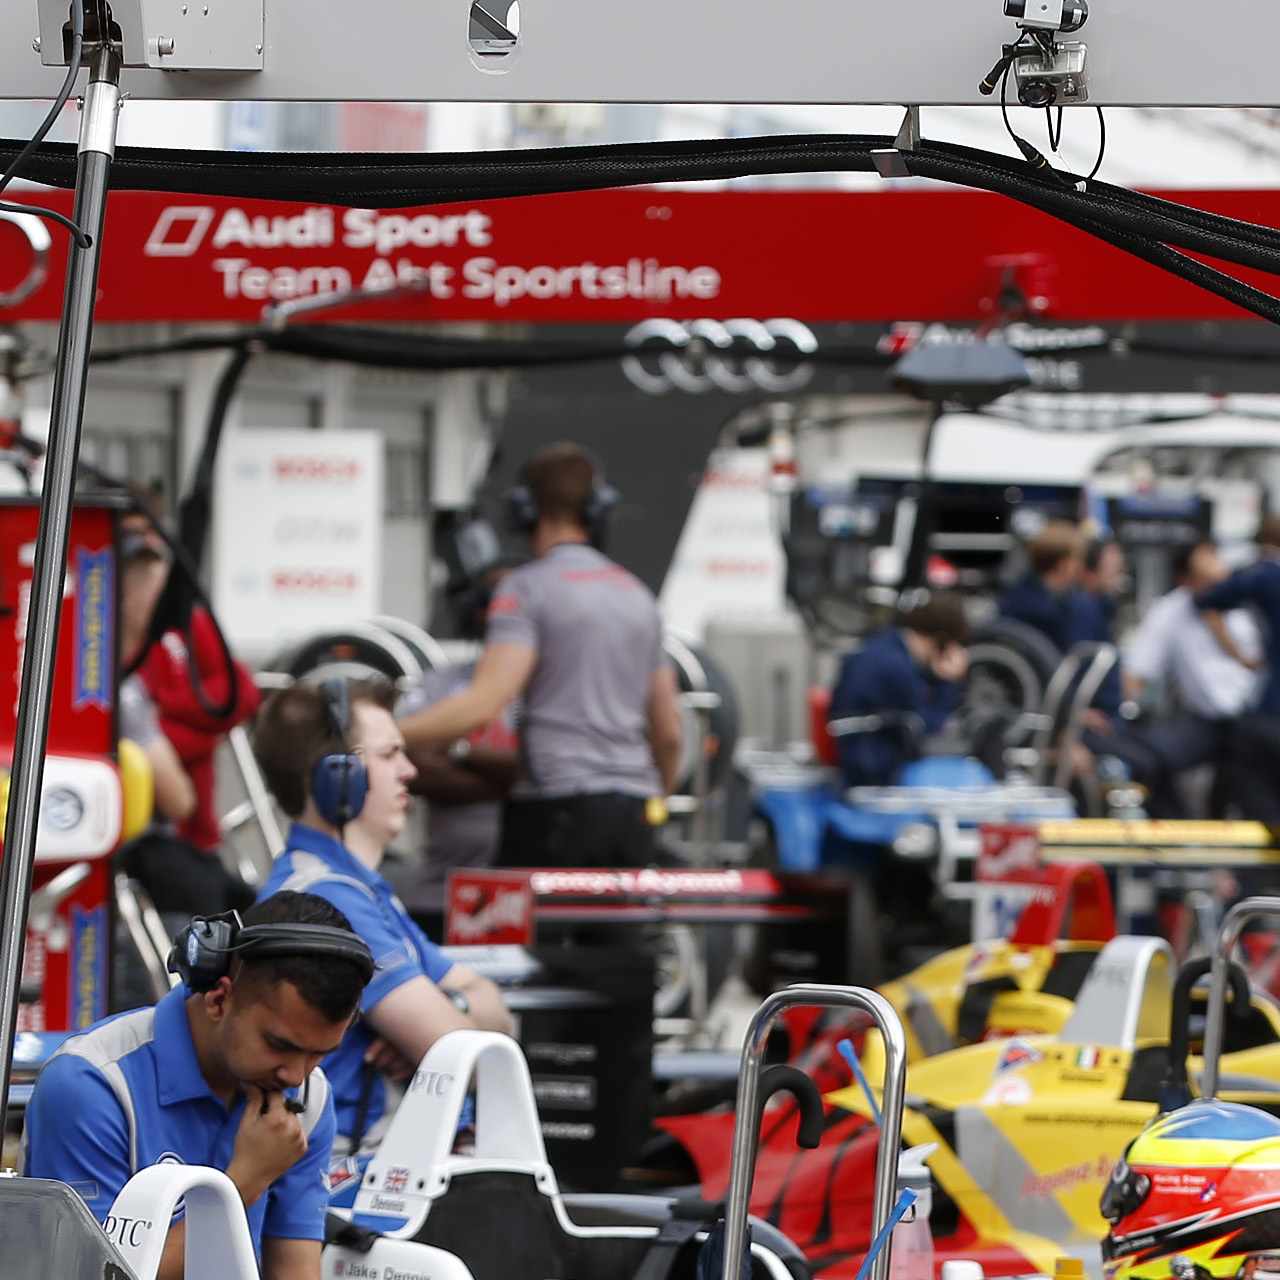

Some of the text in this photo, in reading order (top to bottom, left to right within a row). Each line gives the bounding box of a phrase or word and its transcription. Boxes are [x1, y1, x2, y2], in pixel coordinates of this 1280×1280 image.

[213, 207, 492, 255] Audi Sport
[212, 257, 350, 300] Team
[463, 256, 721, 307] Sportsline
[345, 1263, 378, 1280] Jake
